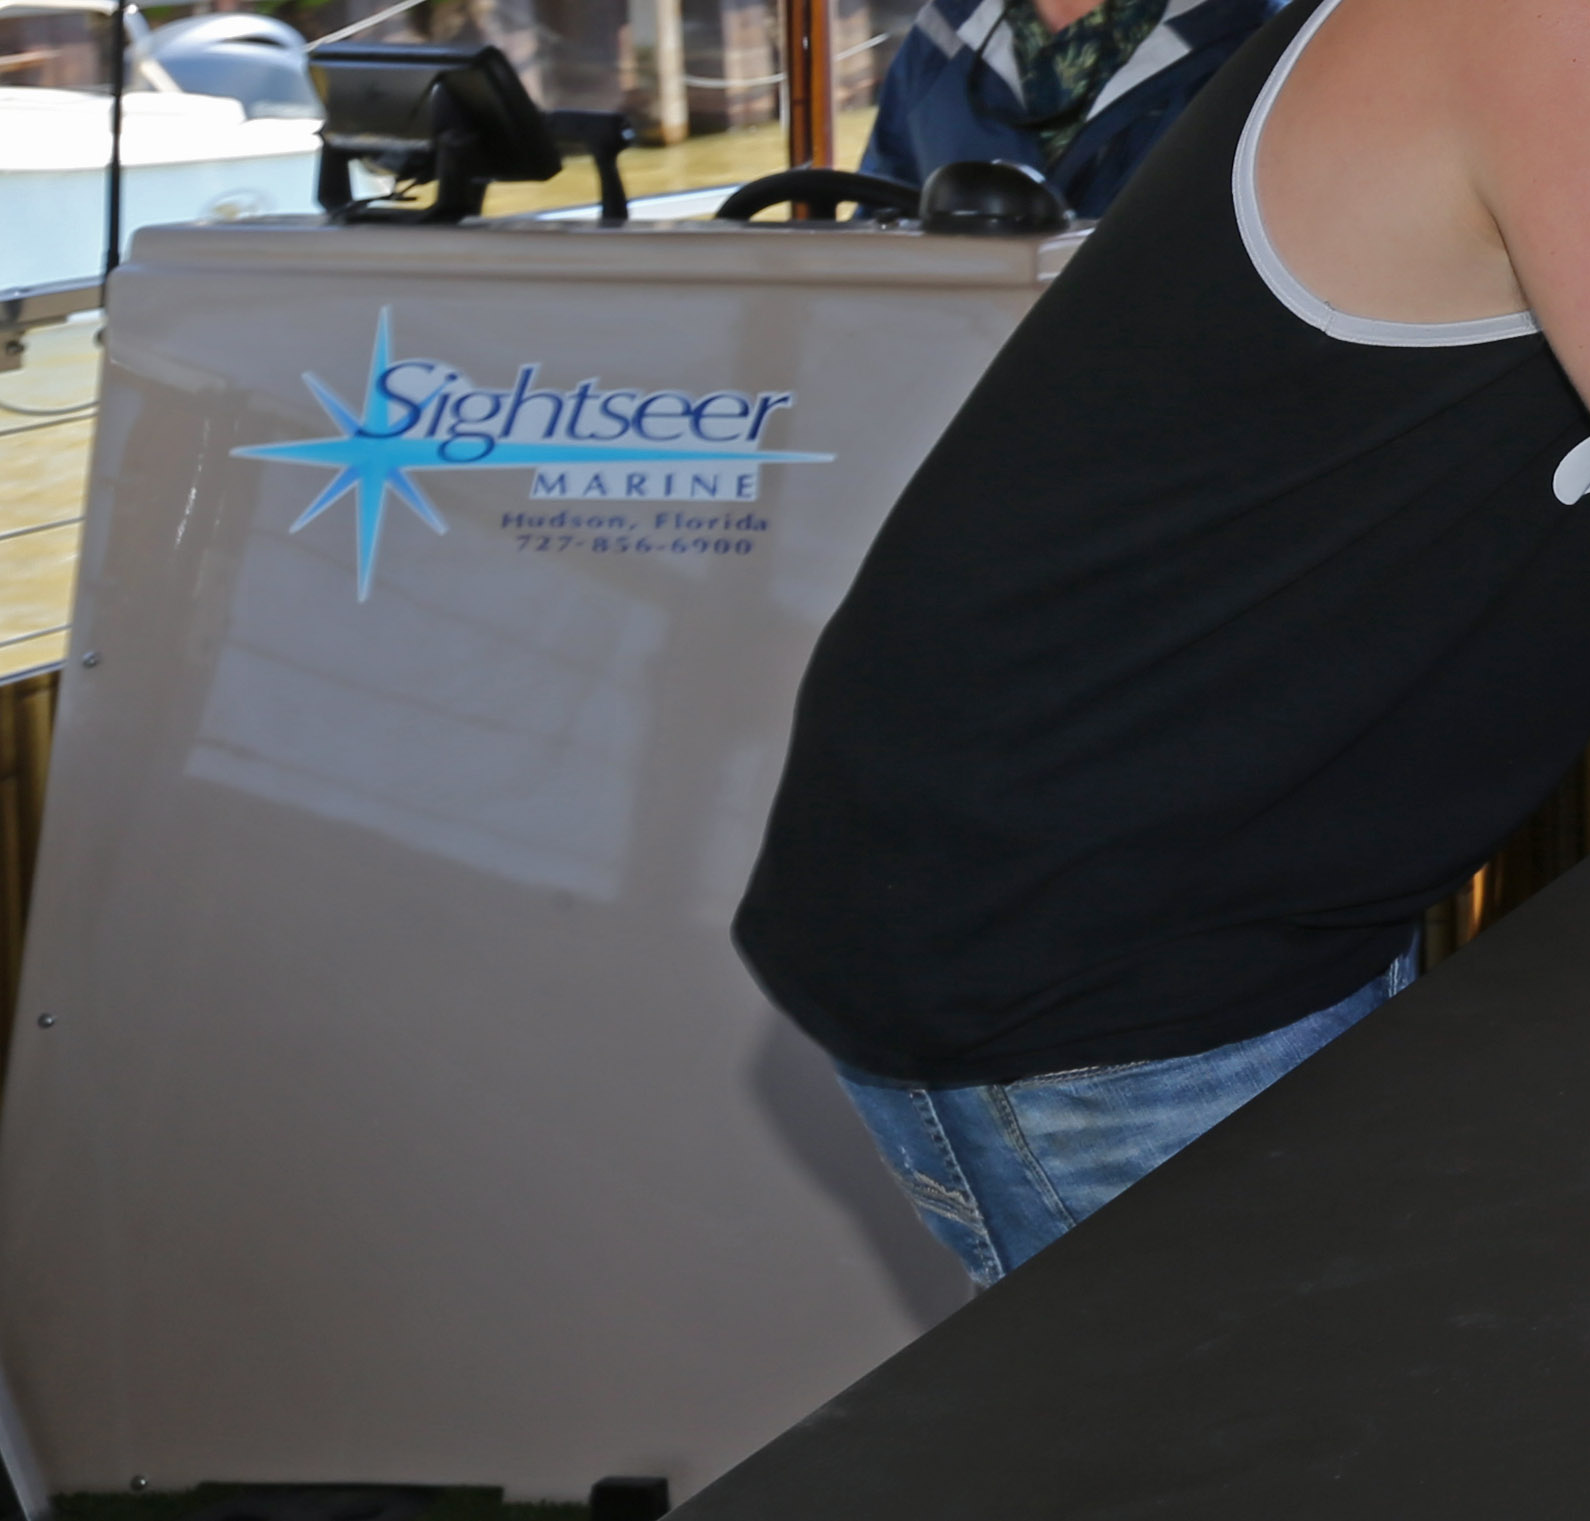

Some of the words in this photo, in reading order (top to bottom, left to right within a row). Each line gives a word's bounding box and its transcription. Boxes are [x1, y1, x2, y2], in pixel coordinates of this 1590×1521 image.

[354, 361, 792, 463] Sightseer
[532, 472, 758, 499] MARINE
[501, 511, 638, 532] Hudson,
[654, 511, 768, 532] Florida
